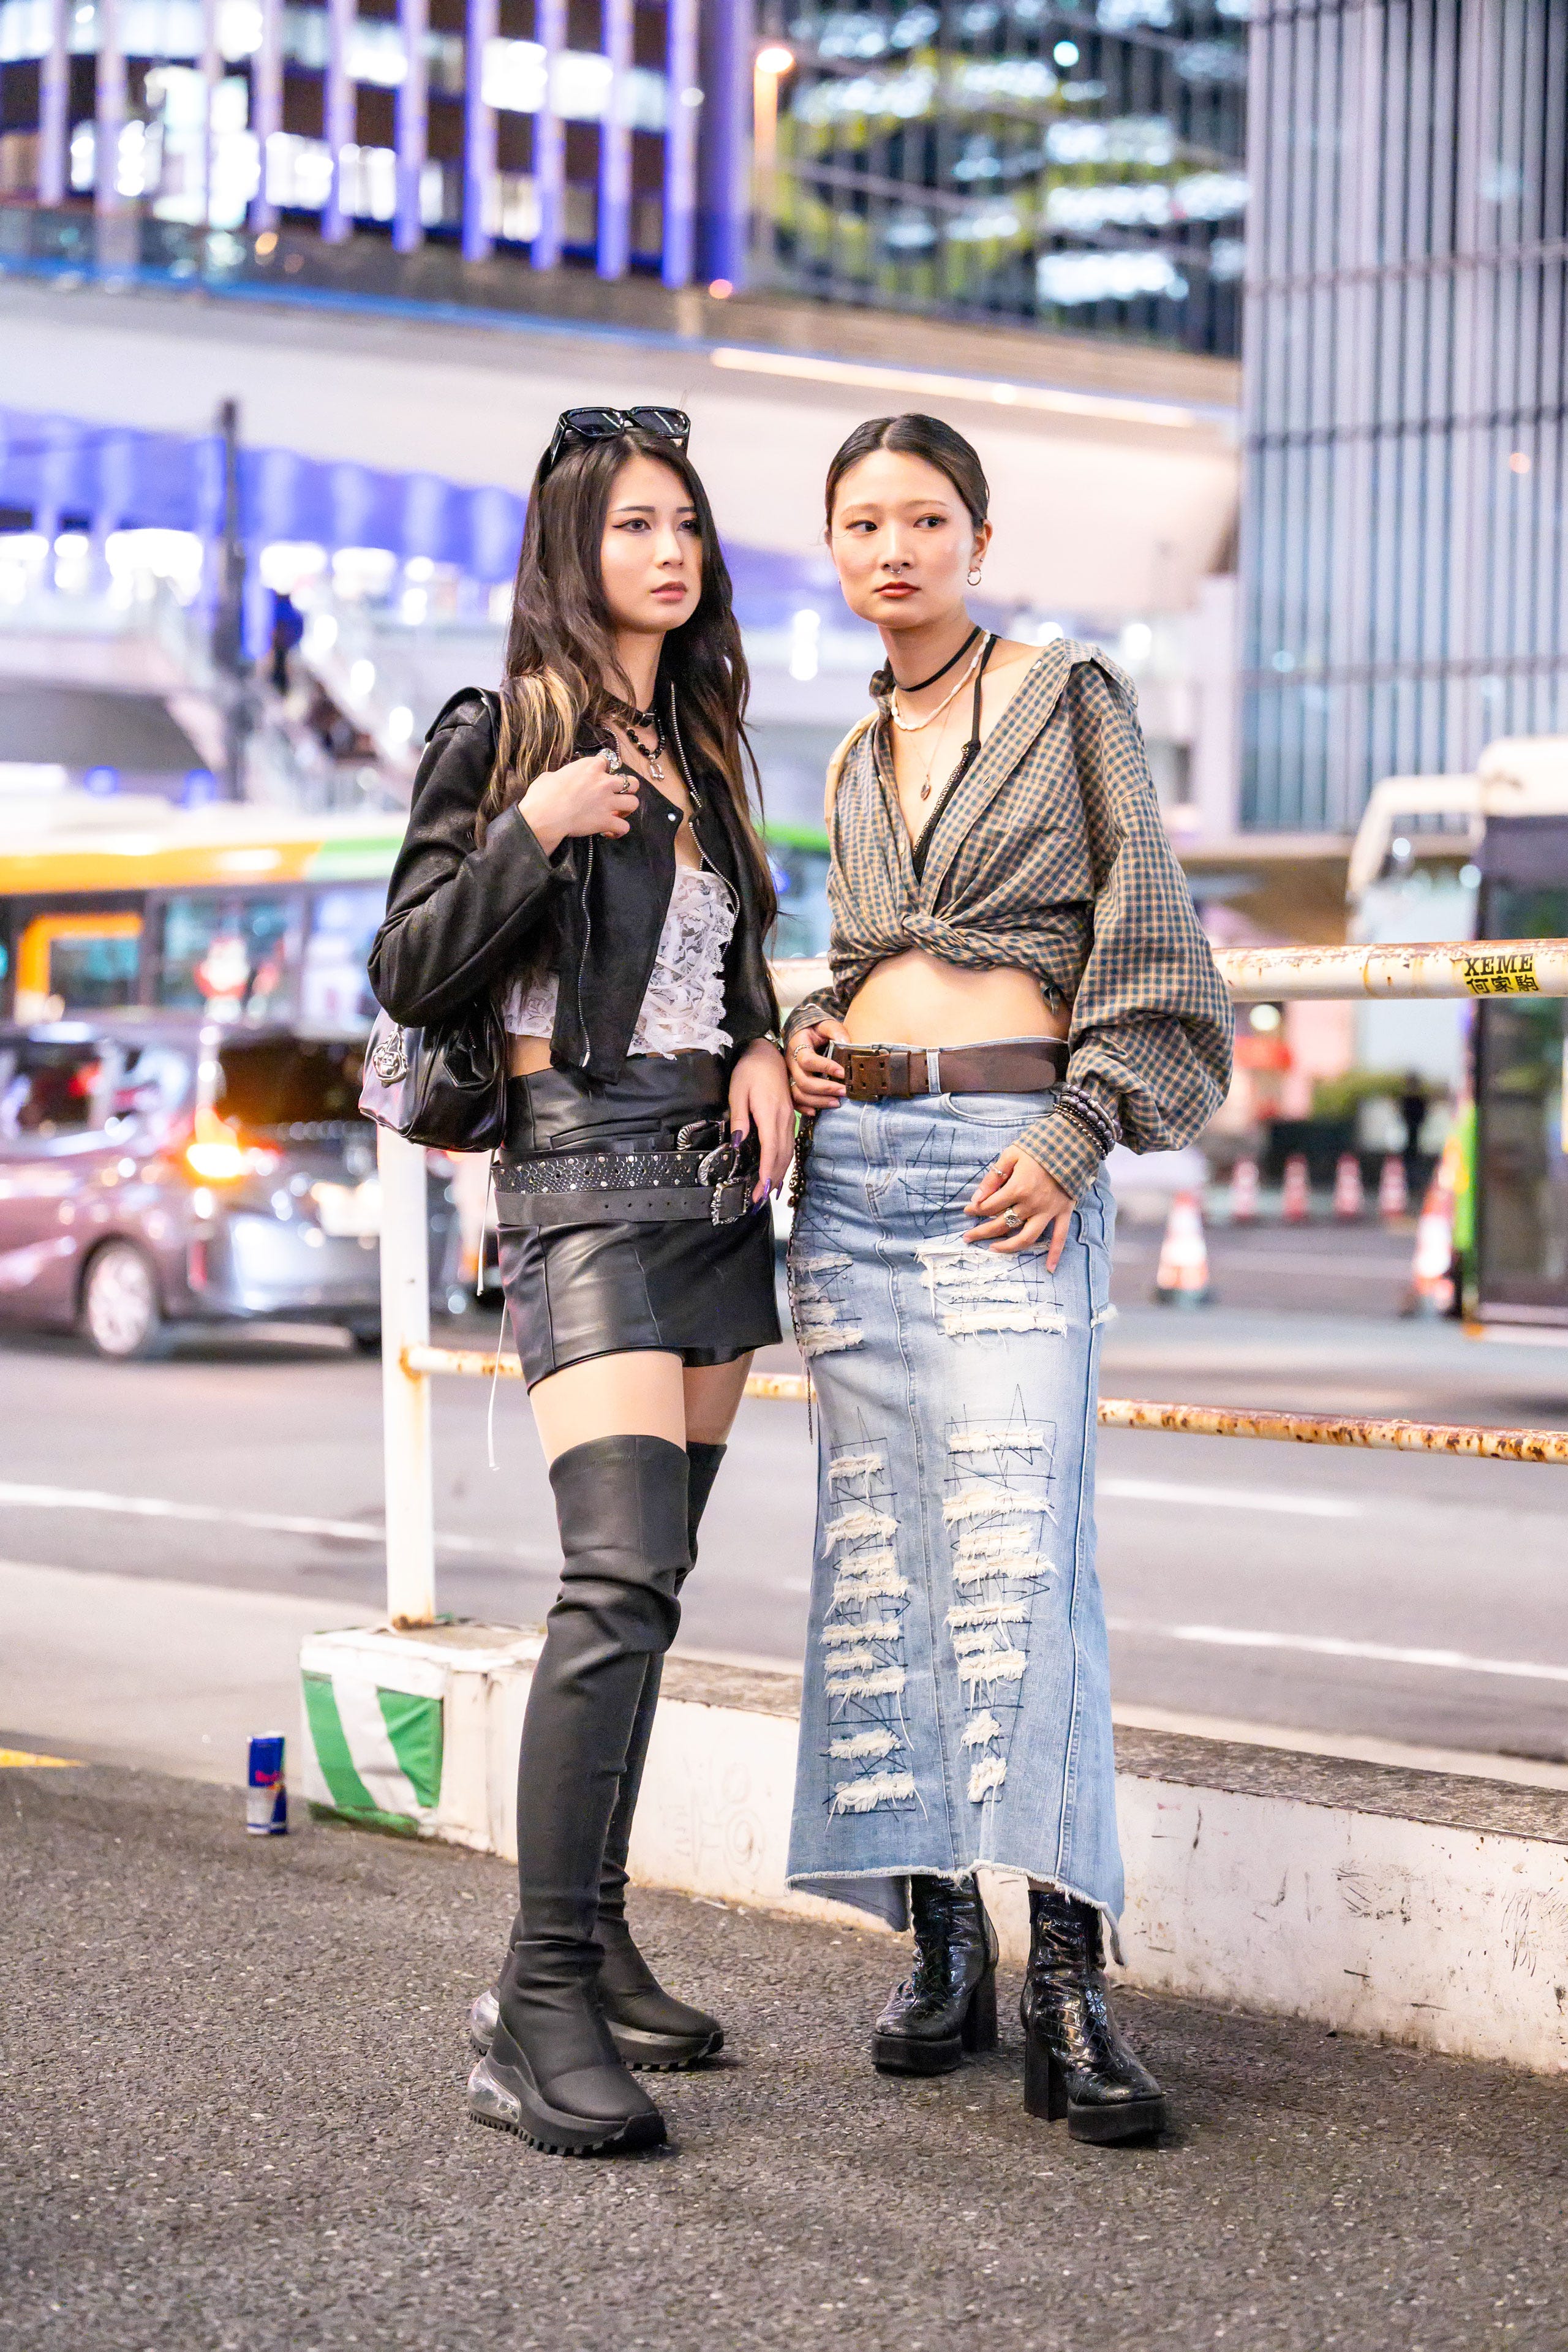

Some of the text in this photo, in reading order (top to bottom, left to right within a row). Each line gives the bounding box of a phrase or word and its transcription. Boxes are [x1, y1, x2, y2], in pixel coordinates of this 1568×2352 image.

[1464, 953, 1534, 976] XEME
[1466, 974, 1539, 995] 何家駒
